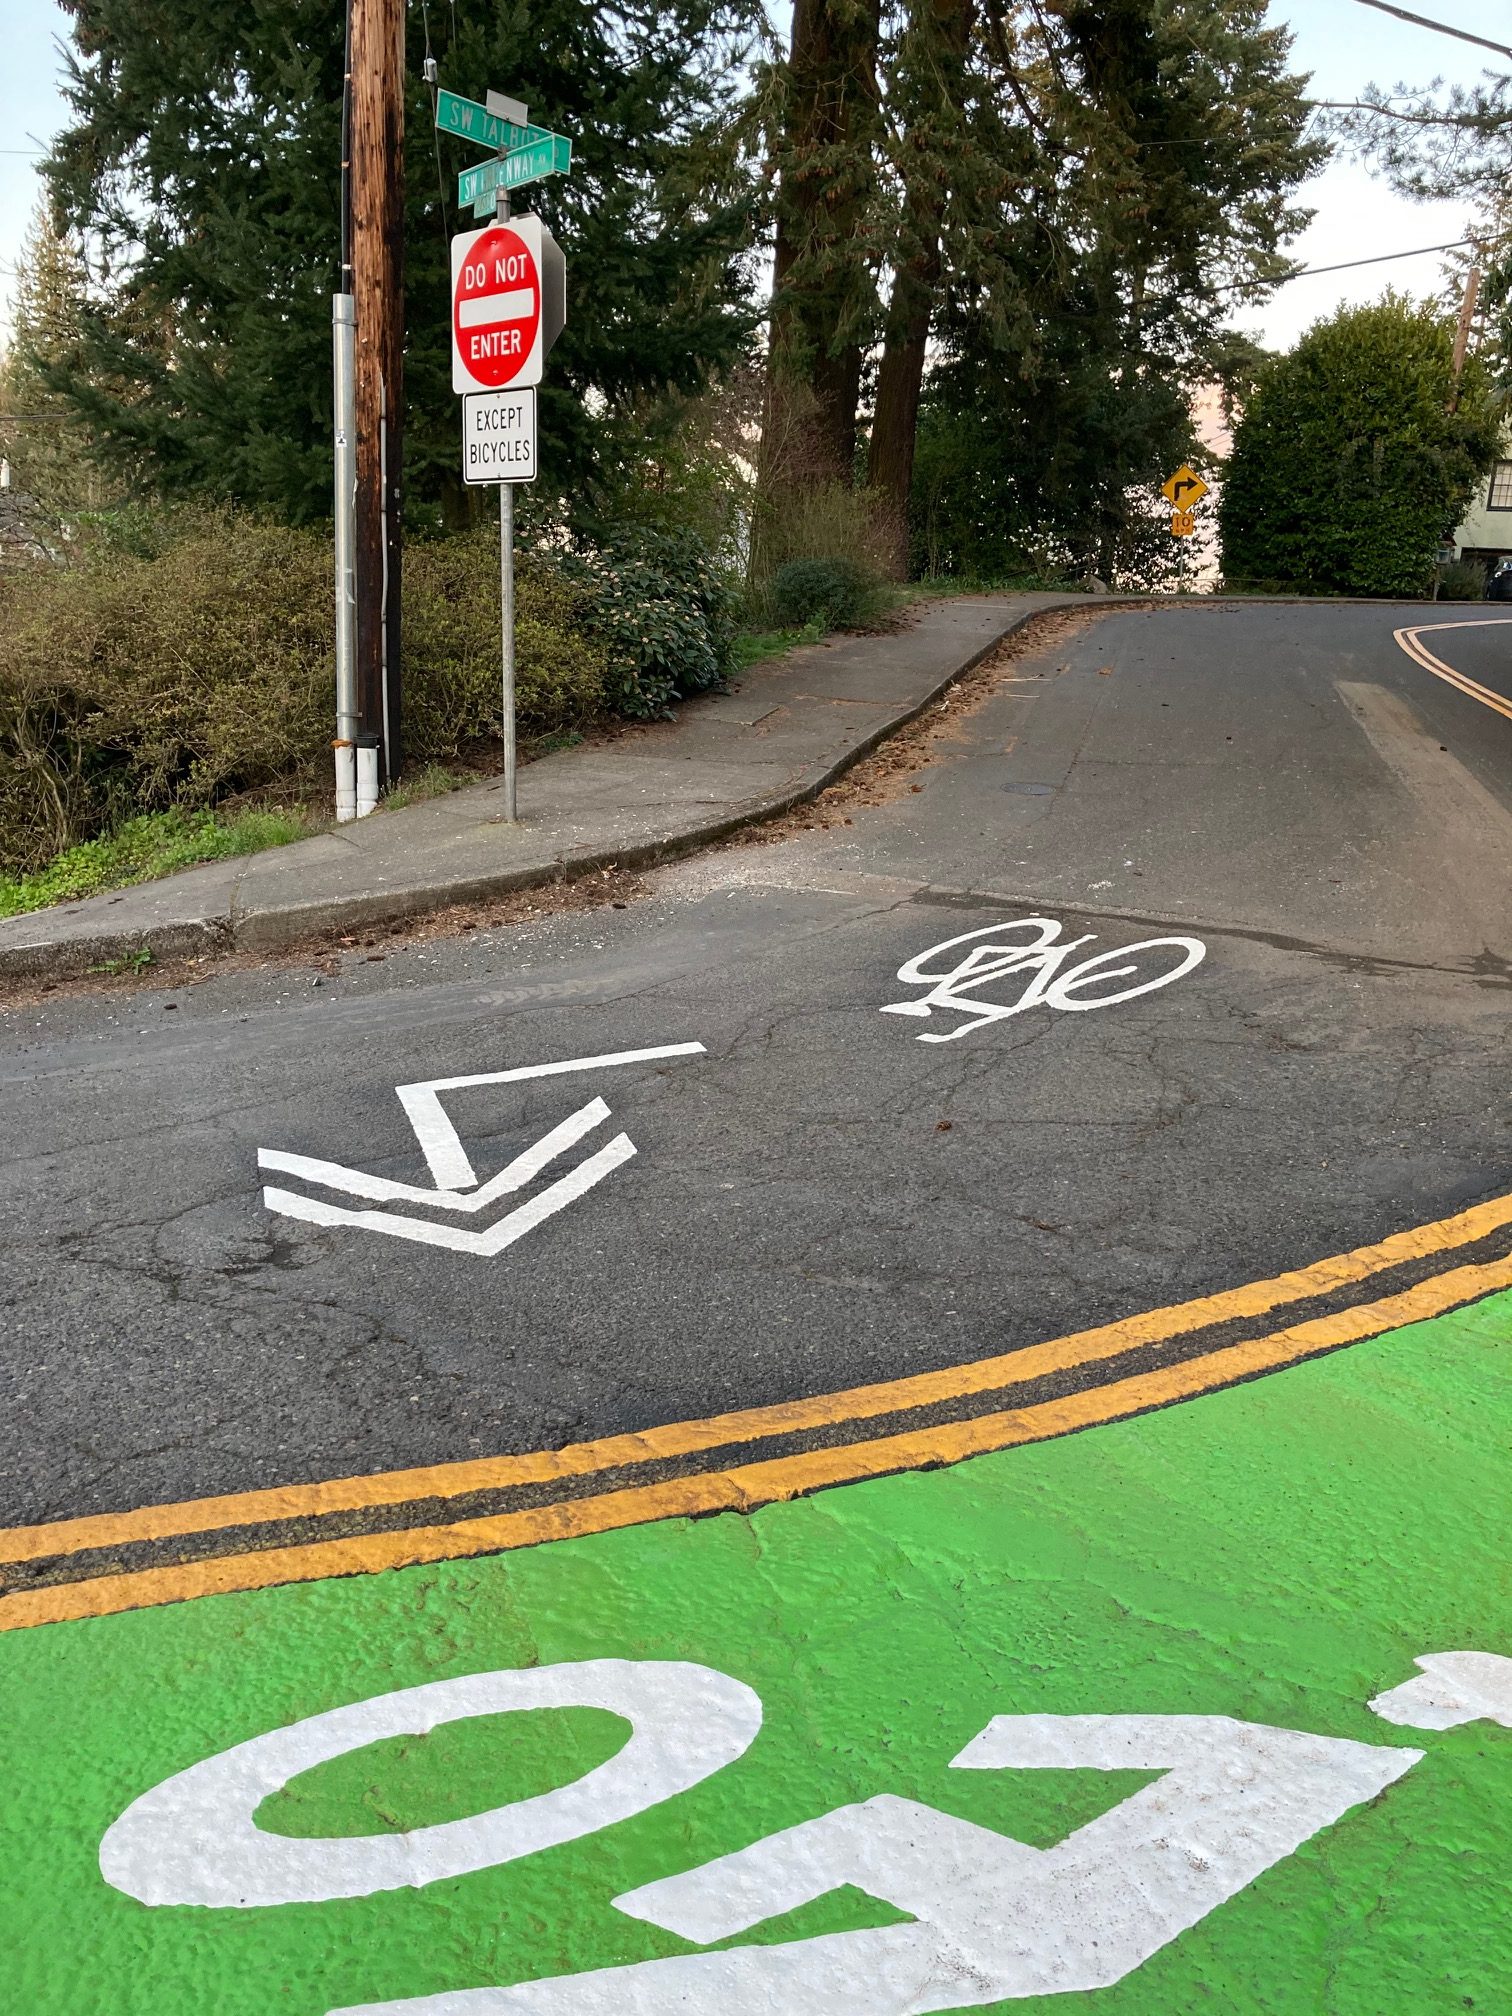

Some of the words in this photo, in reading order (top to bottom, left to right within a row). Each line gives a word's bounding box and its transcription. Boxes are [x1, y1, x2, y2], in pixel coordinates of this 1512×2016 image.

[450, 101, 473, 131] SW
[464, 173, 478, 200] SW
[480, 151, 534, 193] ENWAY
[465, 263, 486, 290] DO
[495, 254, 527, 284] NOT
[470, 329, 521, 360] ENTER
[476, 406, 523, 431] EXCEPT
[470, 439, 530, 464] BICYCLES
[1175, 517, 1190, 527] 10
